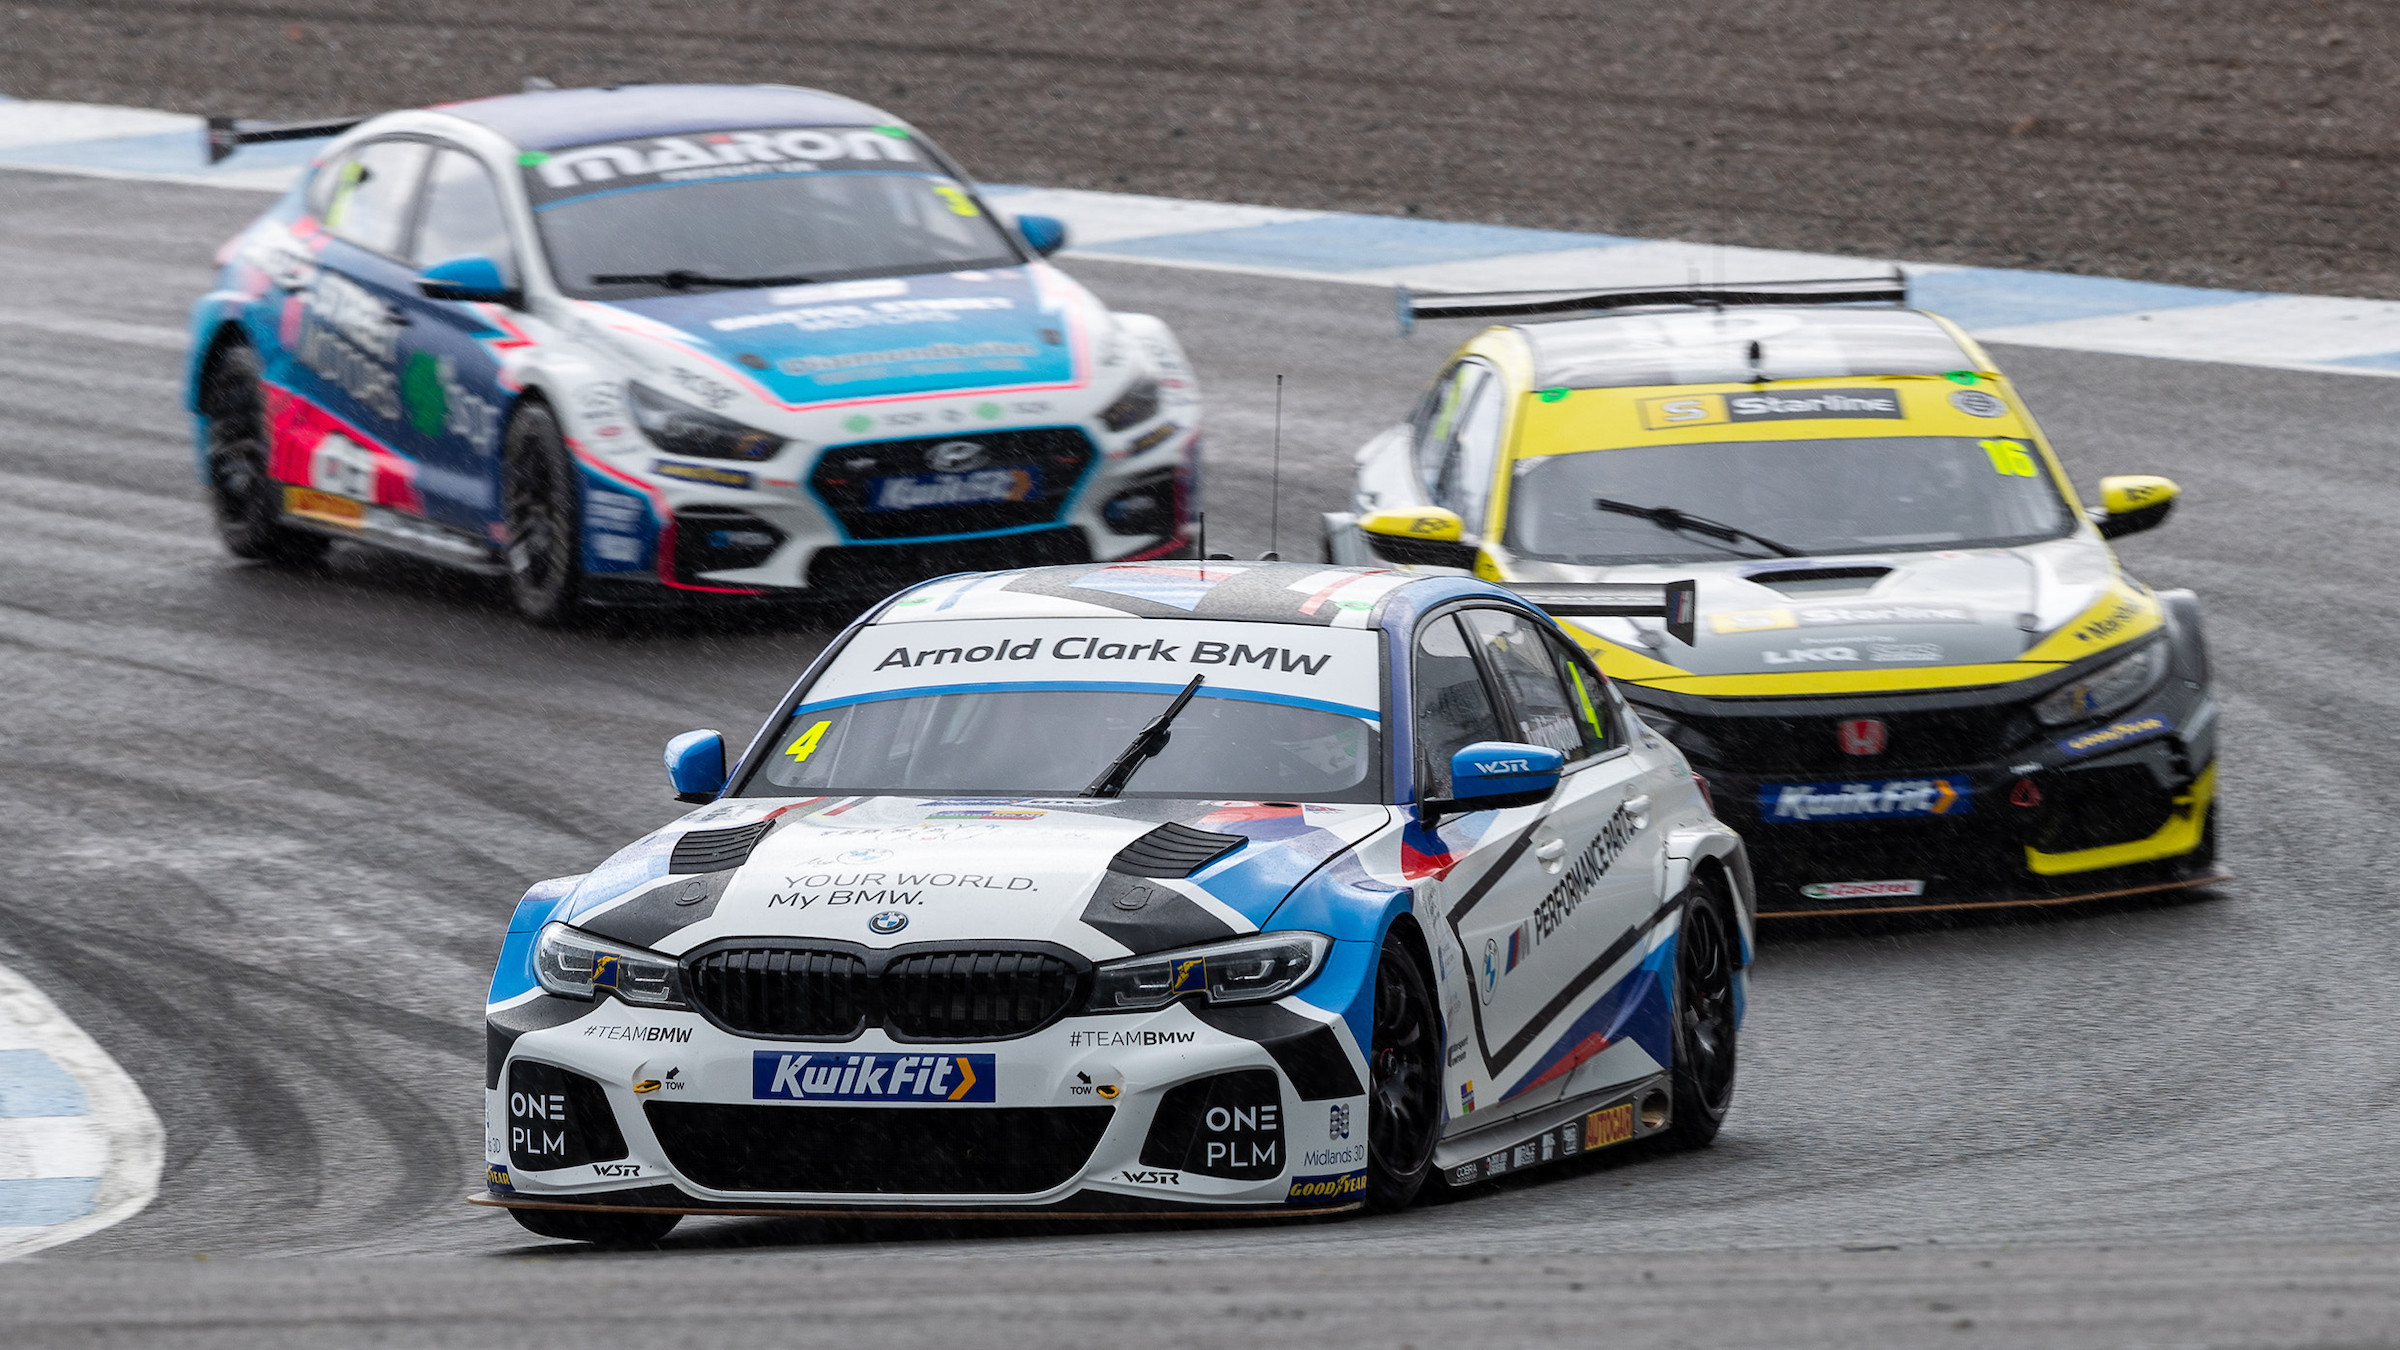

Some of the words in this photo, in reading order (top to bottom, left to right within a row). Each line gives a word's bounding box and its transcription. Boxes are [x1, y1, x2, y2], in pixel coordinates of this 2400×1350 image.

[934, 186, 980, 217] 3
[1733, 395, 1896, 416] Starline
[1978, 439, 2038, 477] 16
[873, 637, 1043, 672] Arnold
[1052, 636, 1180, 664] Clark
[1189, 640, 1332, 677] BMW
[785, 721, 832, 762] 4
[1474, 759, 1531, 773] WSR
[1773, 780, 1938, 820] KwikFit
[784, 872, 887, 889] YOUR
[897, 873, 1039, 892] WORLD.
[1534, 833, 1611, 946] PERFORMANCE
[768, 892, 820, 910] My
[827, 889, 924, 906] BMW.
[583, 1025, 694, 1044] #TEAMBMW
[1069, 1030, 1196, 1048] #TEAMBMW
[665, 1081, 685, 1091] TOW
[770, 1054, 953, 1098] KwikFit
[1070, 1086, 1092, 1096] TOW
[511, 1092, 565, 1120] ONE
[1206, 1104, 1278, 1132] ONE
[512, 1126, 565, 1156] PLM
[1207, 1140, 1277, 1168] PLM
[1303, 1146, 1352, 1167] Midlands
[1353, 1144, 1365, 1162] 3D
[592, 1165, 641, 1178] WSR
[1121, 1171, 1180, 1186] WSR
[1290, 1174, 1367, 1198] GOODYEAR
